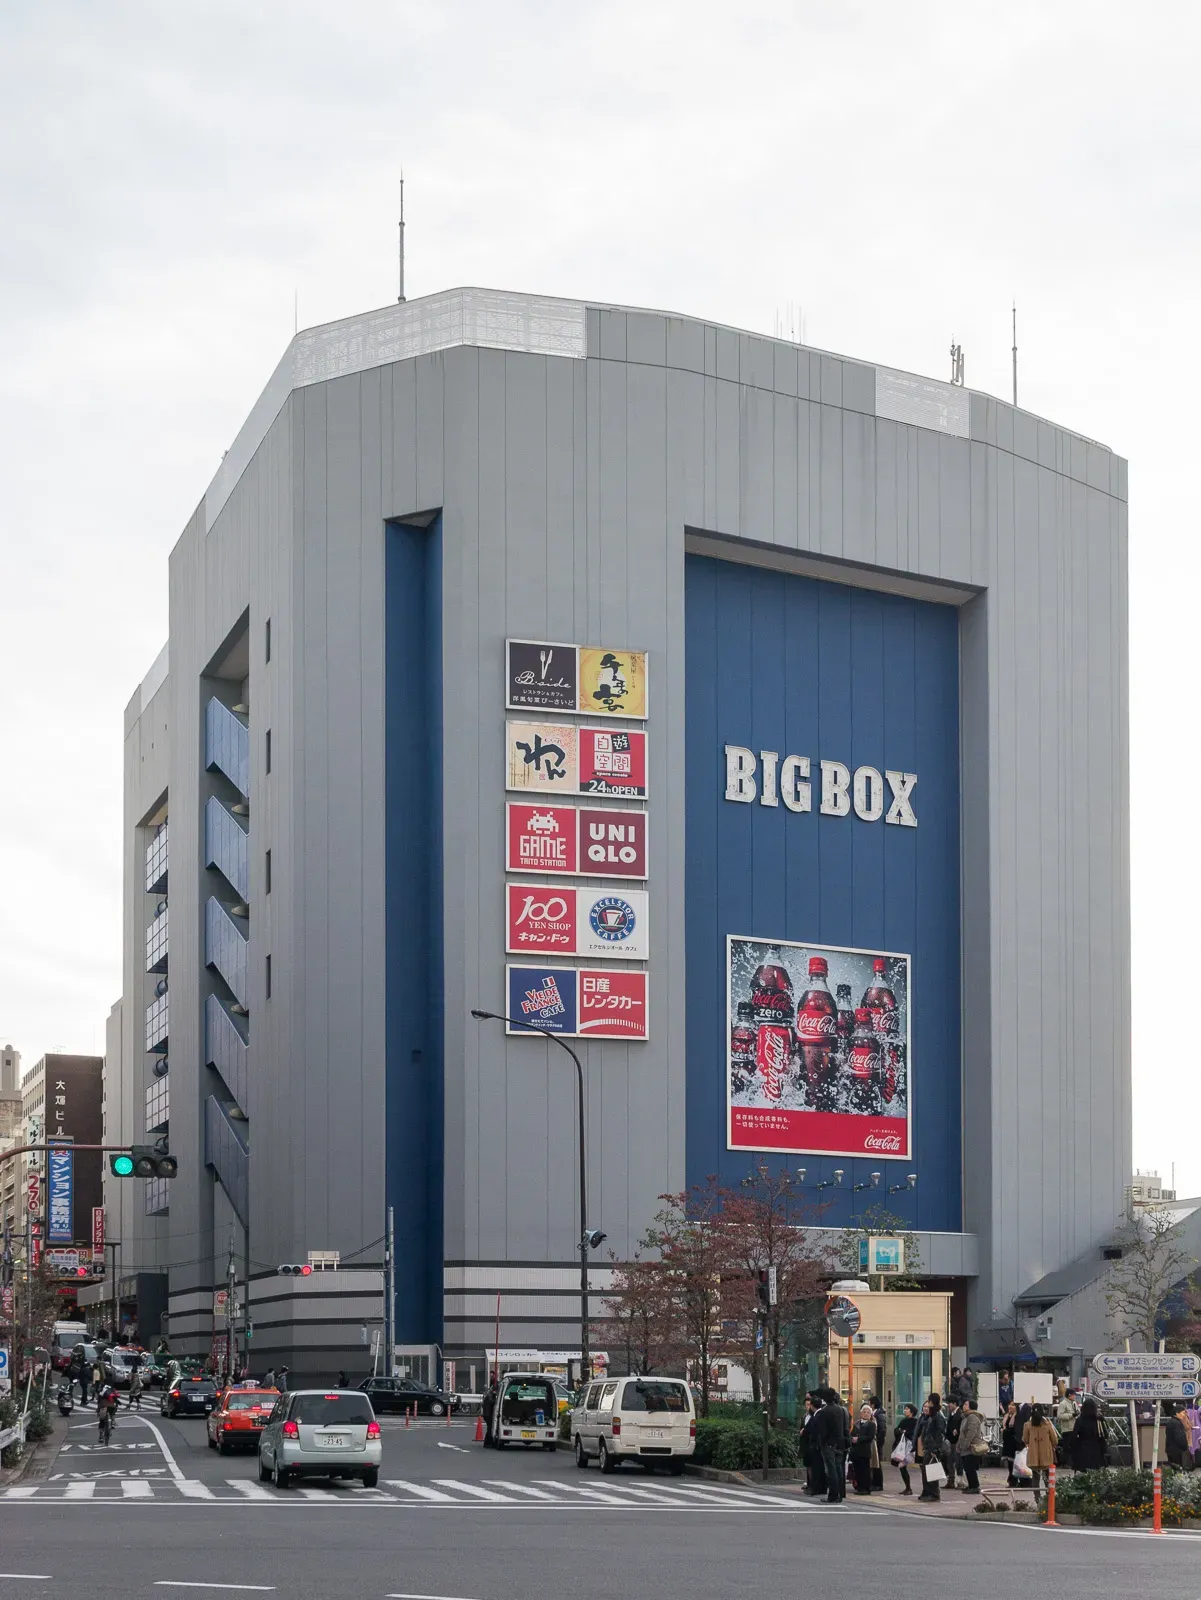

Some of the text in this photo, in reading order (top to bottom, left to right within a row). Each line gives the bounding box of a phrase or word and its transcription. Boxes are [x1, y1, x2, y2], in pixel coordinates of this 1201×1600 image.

[725, 744, 918, 827] BIG BOX
[589, 822, 636, 843] UNI
[519, 834, 567, 859] GAME
[587, 844, 637, 864] QLO
[519, 857, 567, 868] TAITO STATION
[514, 895, 568, 926] 100
[590, 897, 635, 920] EXCELSIOR
[528, 921, 572, 931] YEN SHOP
[596, 927, 629, 941] CAFFE
[583, 977, 610, 993] 日産
[521, 994, 561, 1014] FRANCE
[583, 994, 642, 1010] レンタカー
[760, 1008, 783, 1018] zero
[799, 1013, 836, 1034] Coca-Cola
[764, 1029, 785, 1103] Coca-Cola
[847, 1050, 880, 1069] Coca-Cola
[29, 1130, 39, 1166] ルノール
[864, 1134, 902, 1151] Coca-Cola
[1117, 1357, 1180, 1366] 新宿コズミックセンター
[1117, 1382, 1180, 1390] 障害者福祉センター
